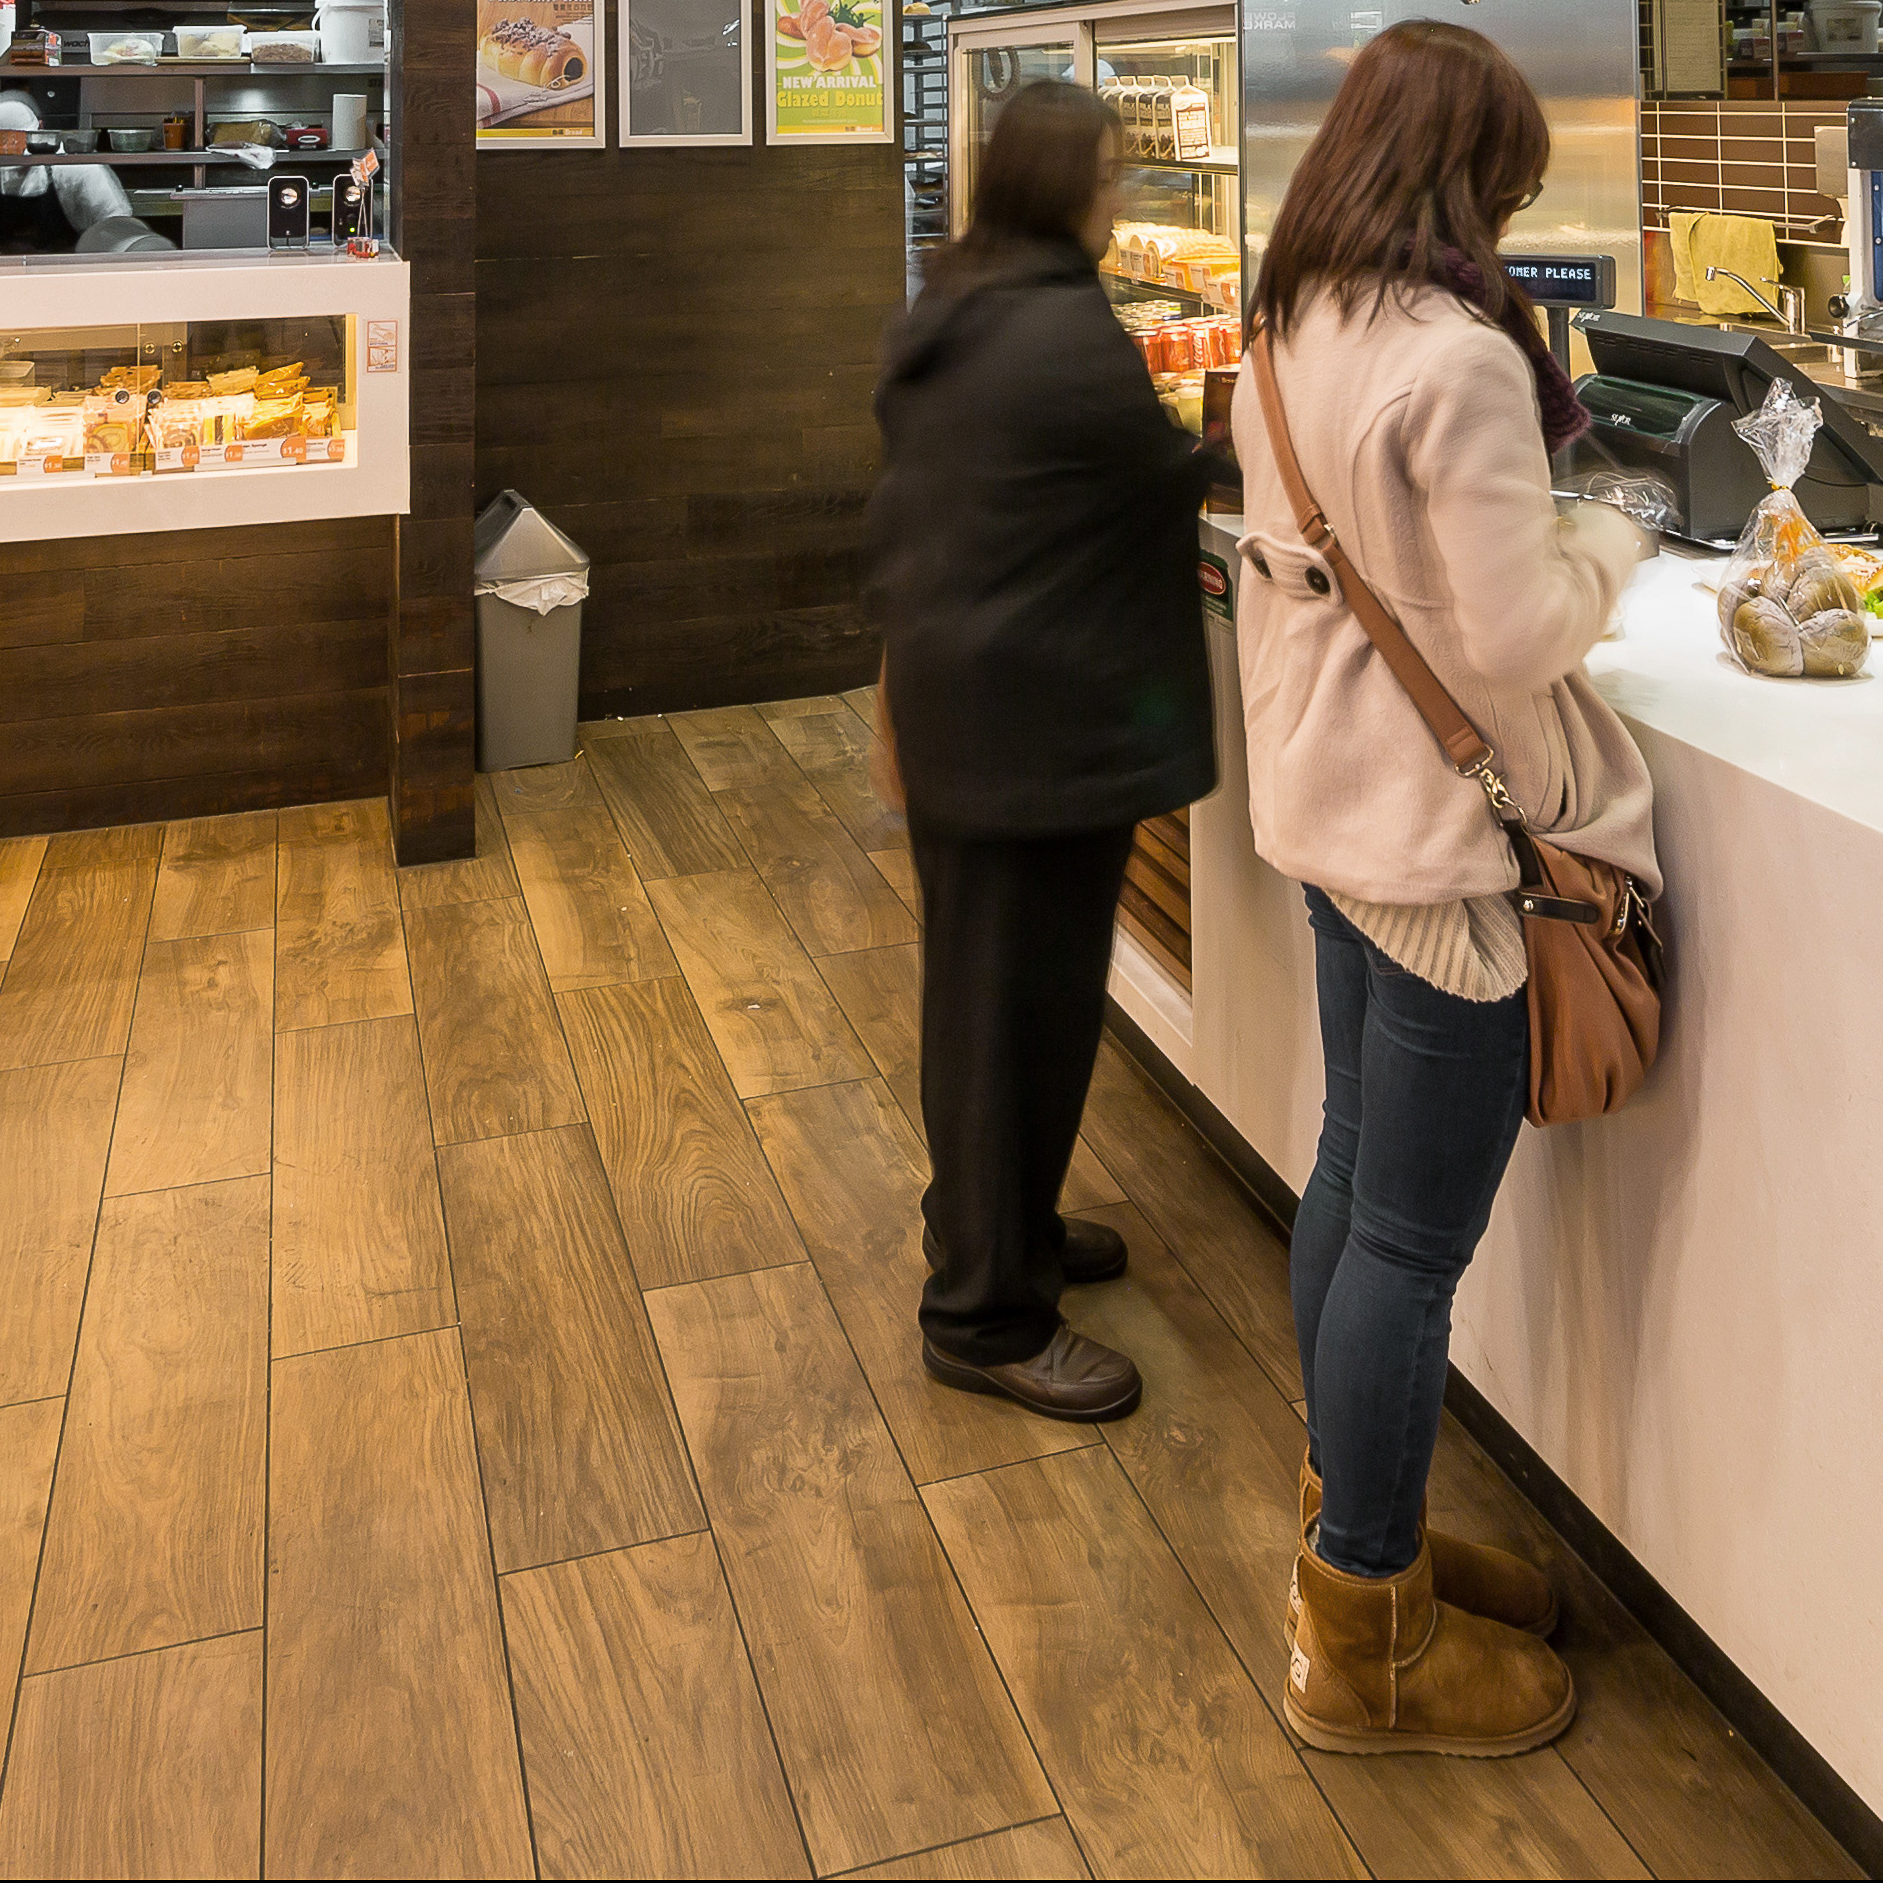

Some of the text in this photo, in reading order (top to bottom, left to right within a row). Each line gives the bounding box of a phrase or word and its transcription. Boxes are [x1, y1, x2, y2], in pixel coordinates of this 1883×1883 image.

[782, 75, 877, 89] NEW ARRIVAL
[776, 90, 883, 108] Glazed Donut
[1505, 266, 1592, 280] OMER PLEASE
